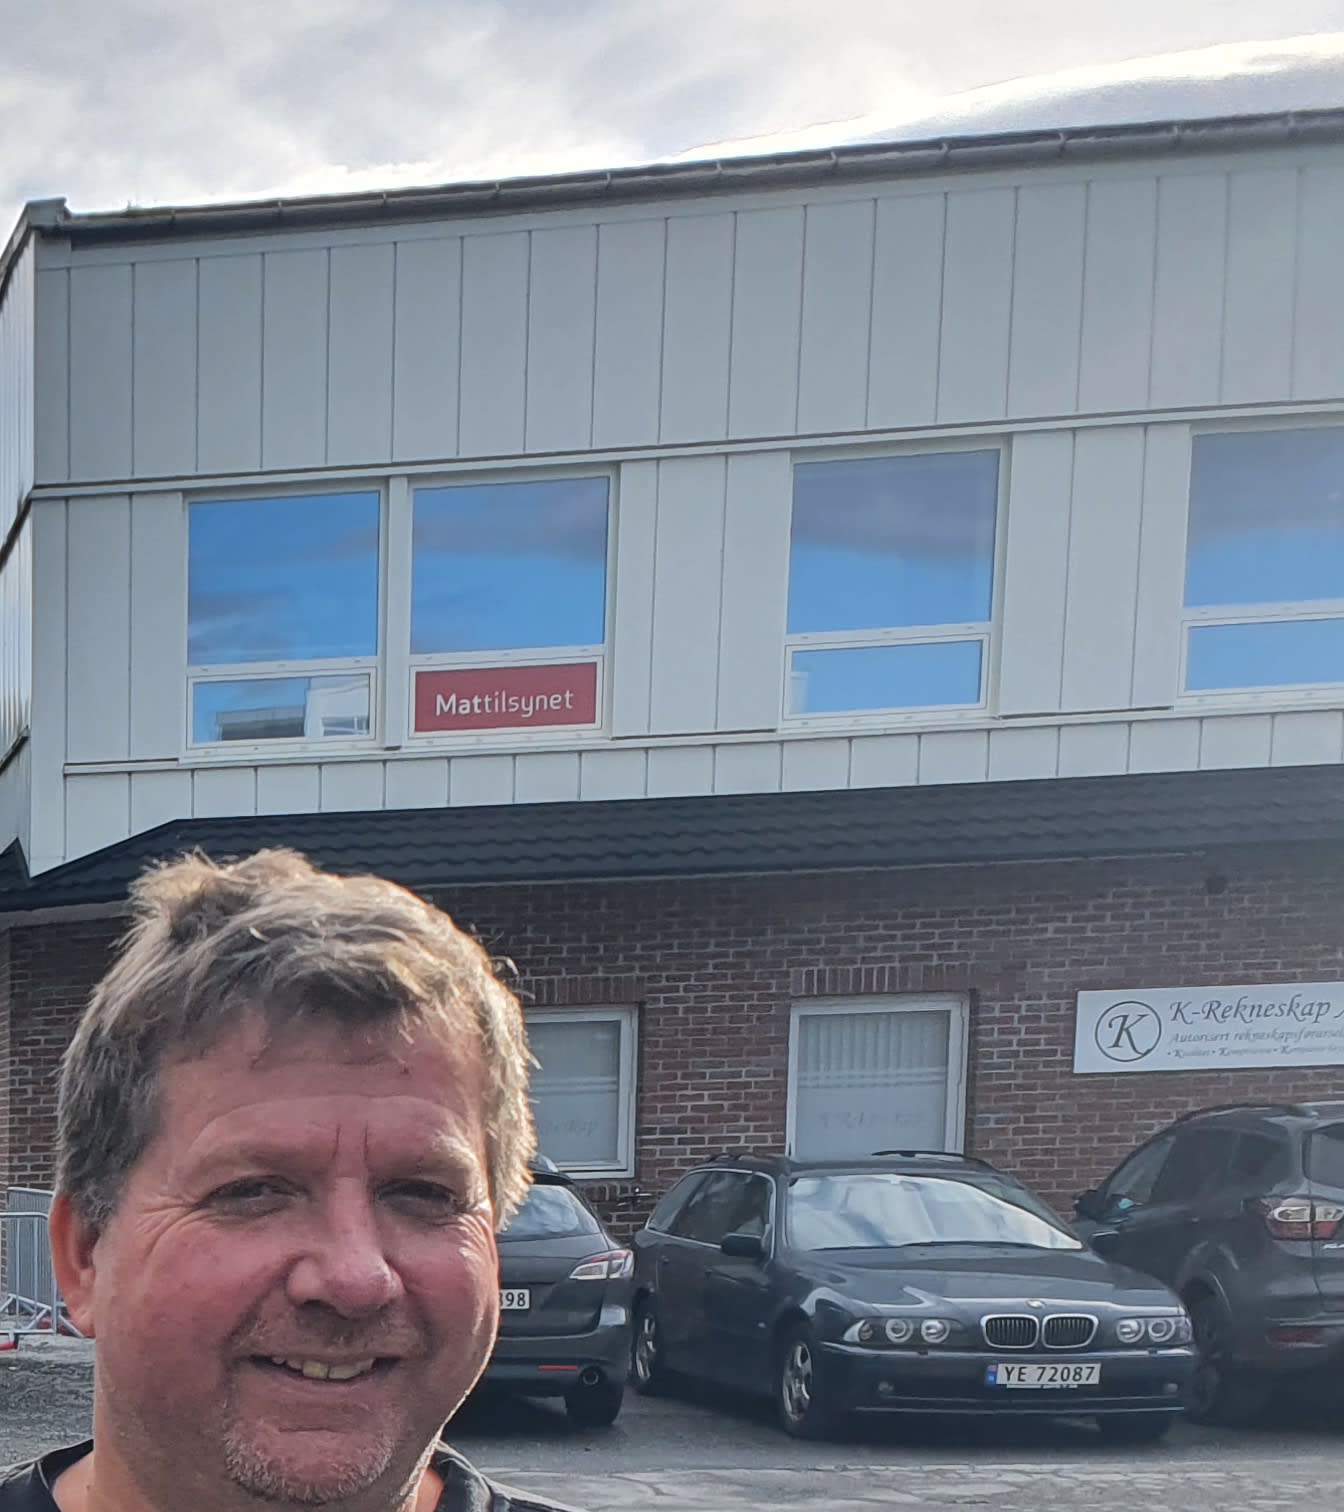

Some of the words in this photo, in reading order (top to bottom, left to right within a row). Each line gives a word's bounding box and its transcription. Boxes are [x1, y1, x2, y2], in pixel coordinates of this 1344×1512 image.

[435, 689, 574, 718] Mattilsynet
[1169, 993, 1331, 1024] K-Rekneskap
[1106, 1013, 1150, 1055] K
[1004, 1366, 1028, 1382] YE
[1036, 1366, 1096, 1382] 72087
